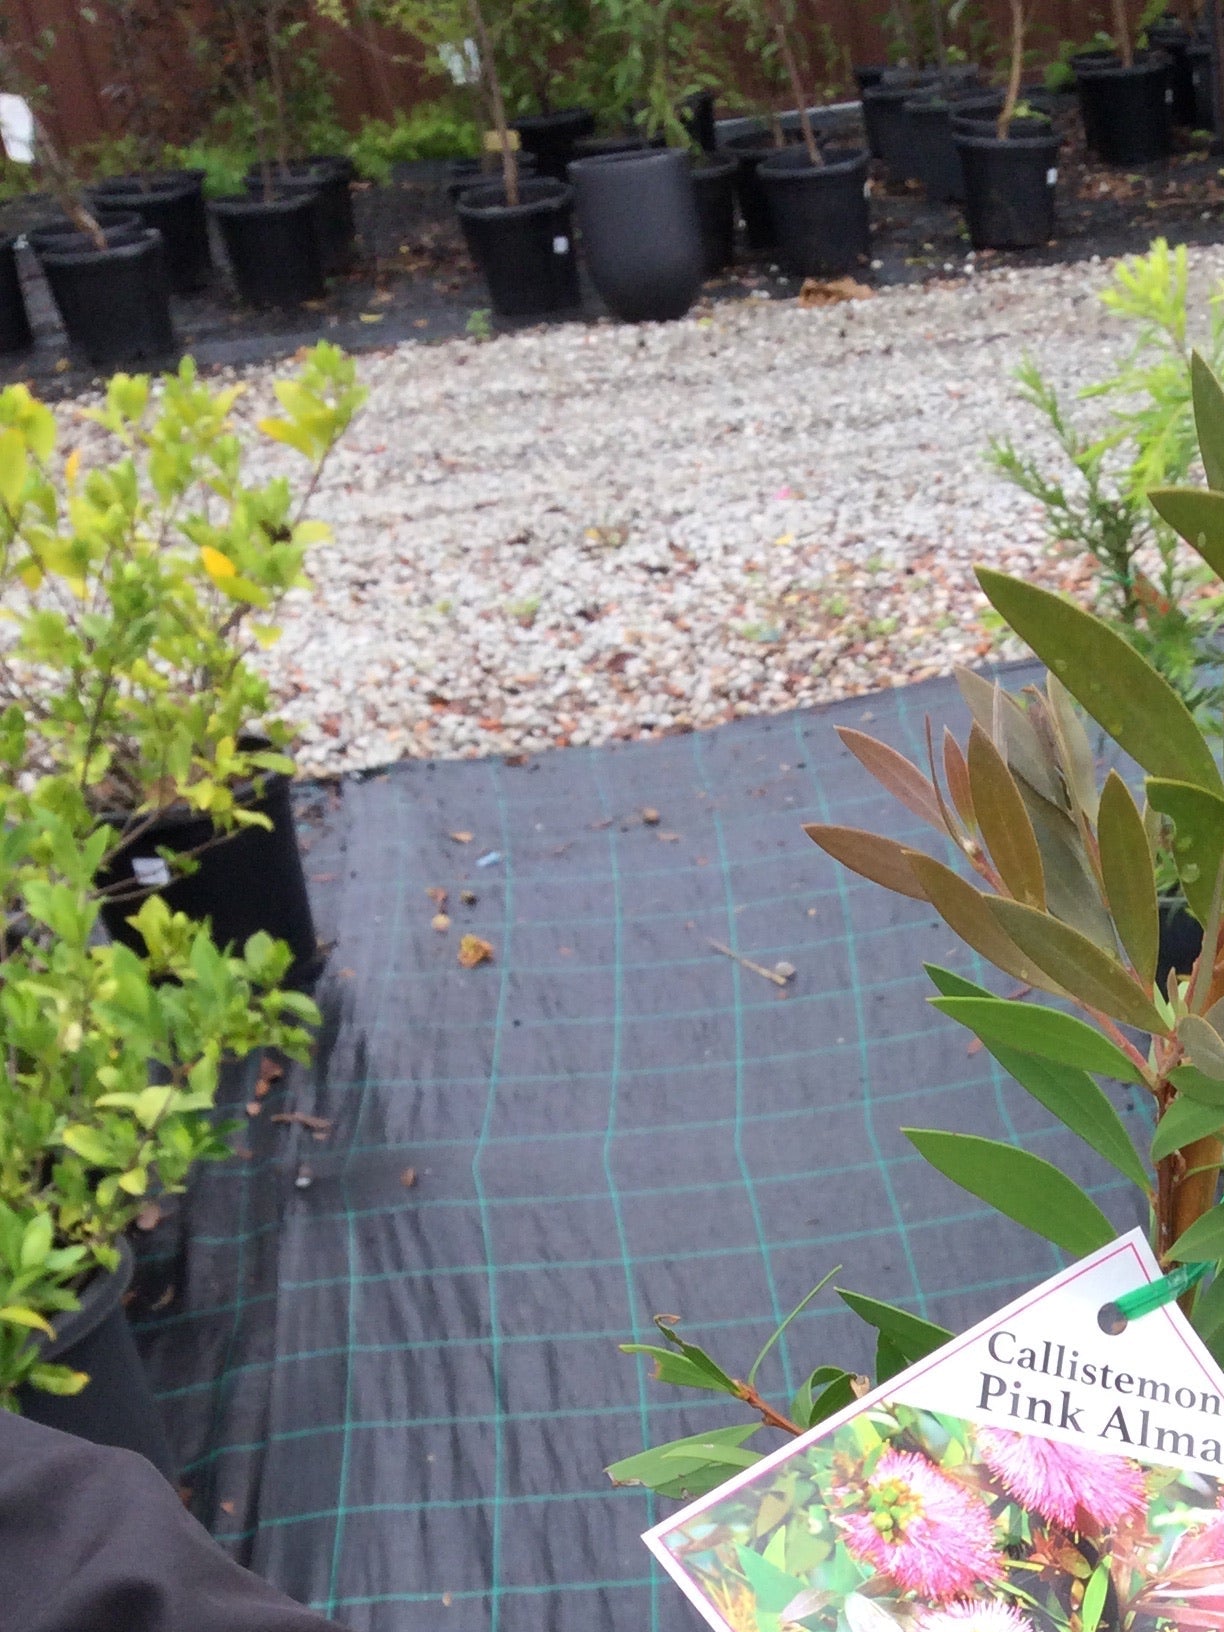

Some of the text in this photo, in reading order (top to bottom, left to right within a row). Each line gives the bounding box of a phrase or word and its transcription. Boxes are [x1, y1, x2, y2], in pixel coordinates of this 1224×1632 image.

[976, 1371, 1224, 1465] Pink Alma
[988, 1331, 1222, 1416] Callistemon
